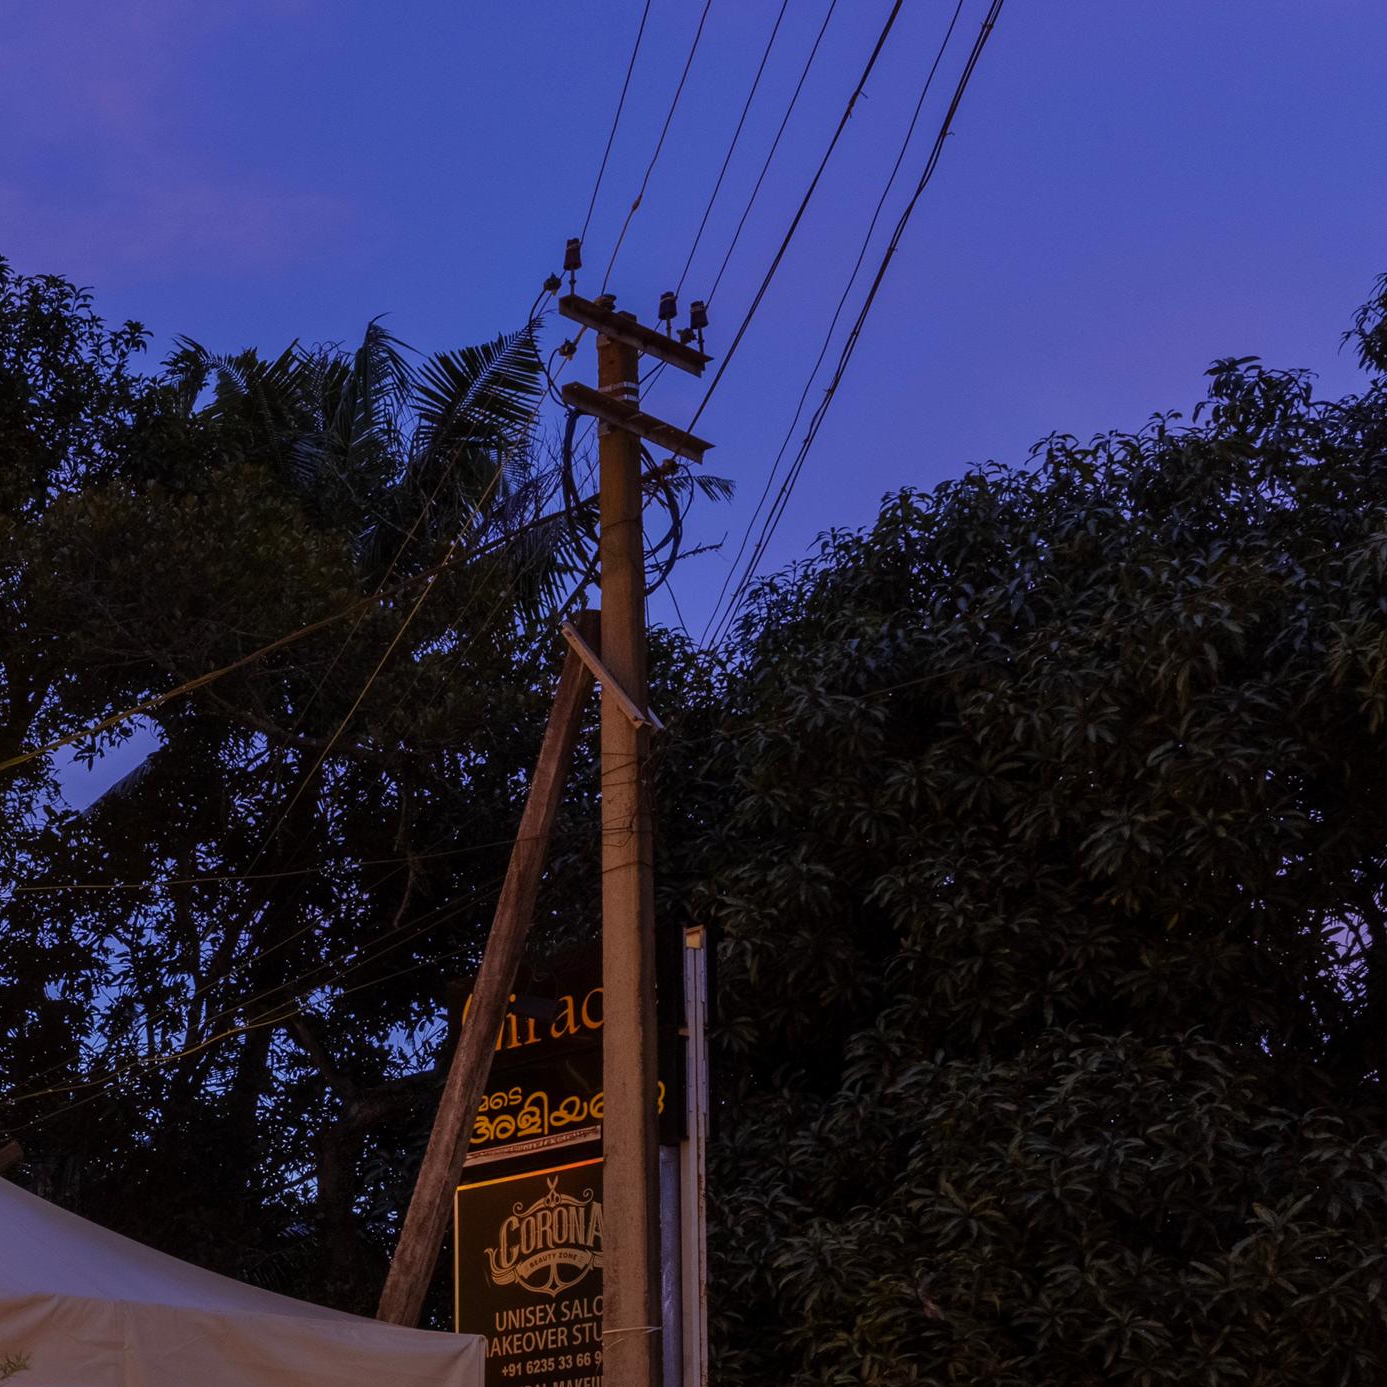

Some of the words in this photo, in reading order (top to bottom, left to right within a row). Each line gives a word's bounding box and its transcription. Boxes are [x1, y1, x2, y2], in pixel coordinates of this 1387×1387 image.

[498, 1201, 604, 1270] CORONA
[529, 1254, 557, 1269] BEAUTY
[558, 1252, 579, 1262] ZONE
[495, 1303, 557, 1332] UNISEX
[561, 1295, 604, 1323] SALO
[571, 1320, 604, 1346] STU
[501, 1361, 523, 1377] +91
[526, 1357, 555, 1376] 6235
[558, 1354, 574, 1370] 33
[575, 1352, 592, 1368] 66
